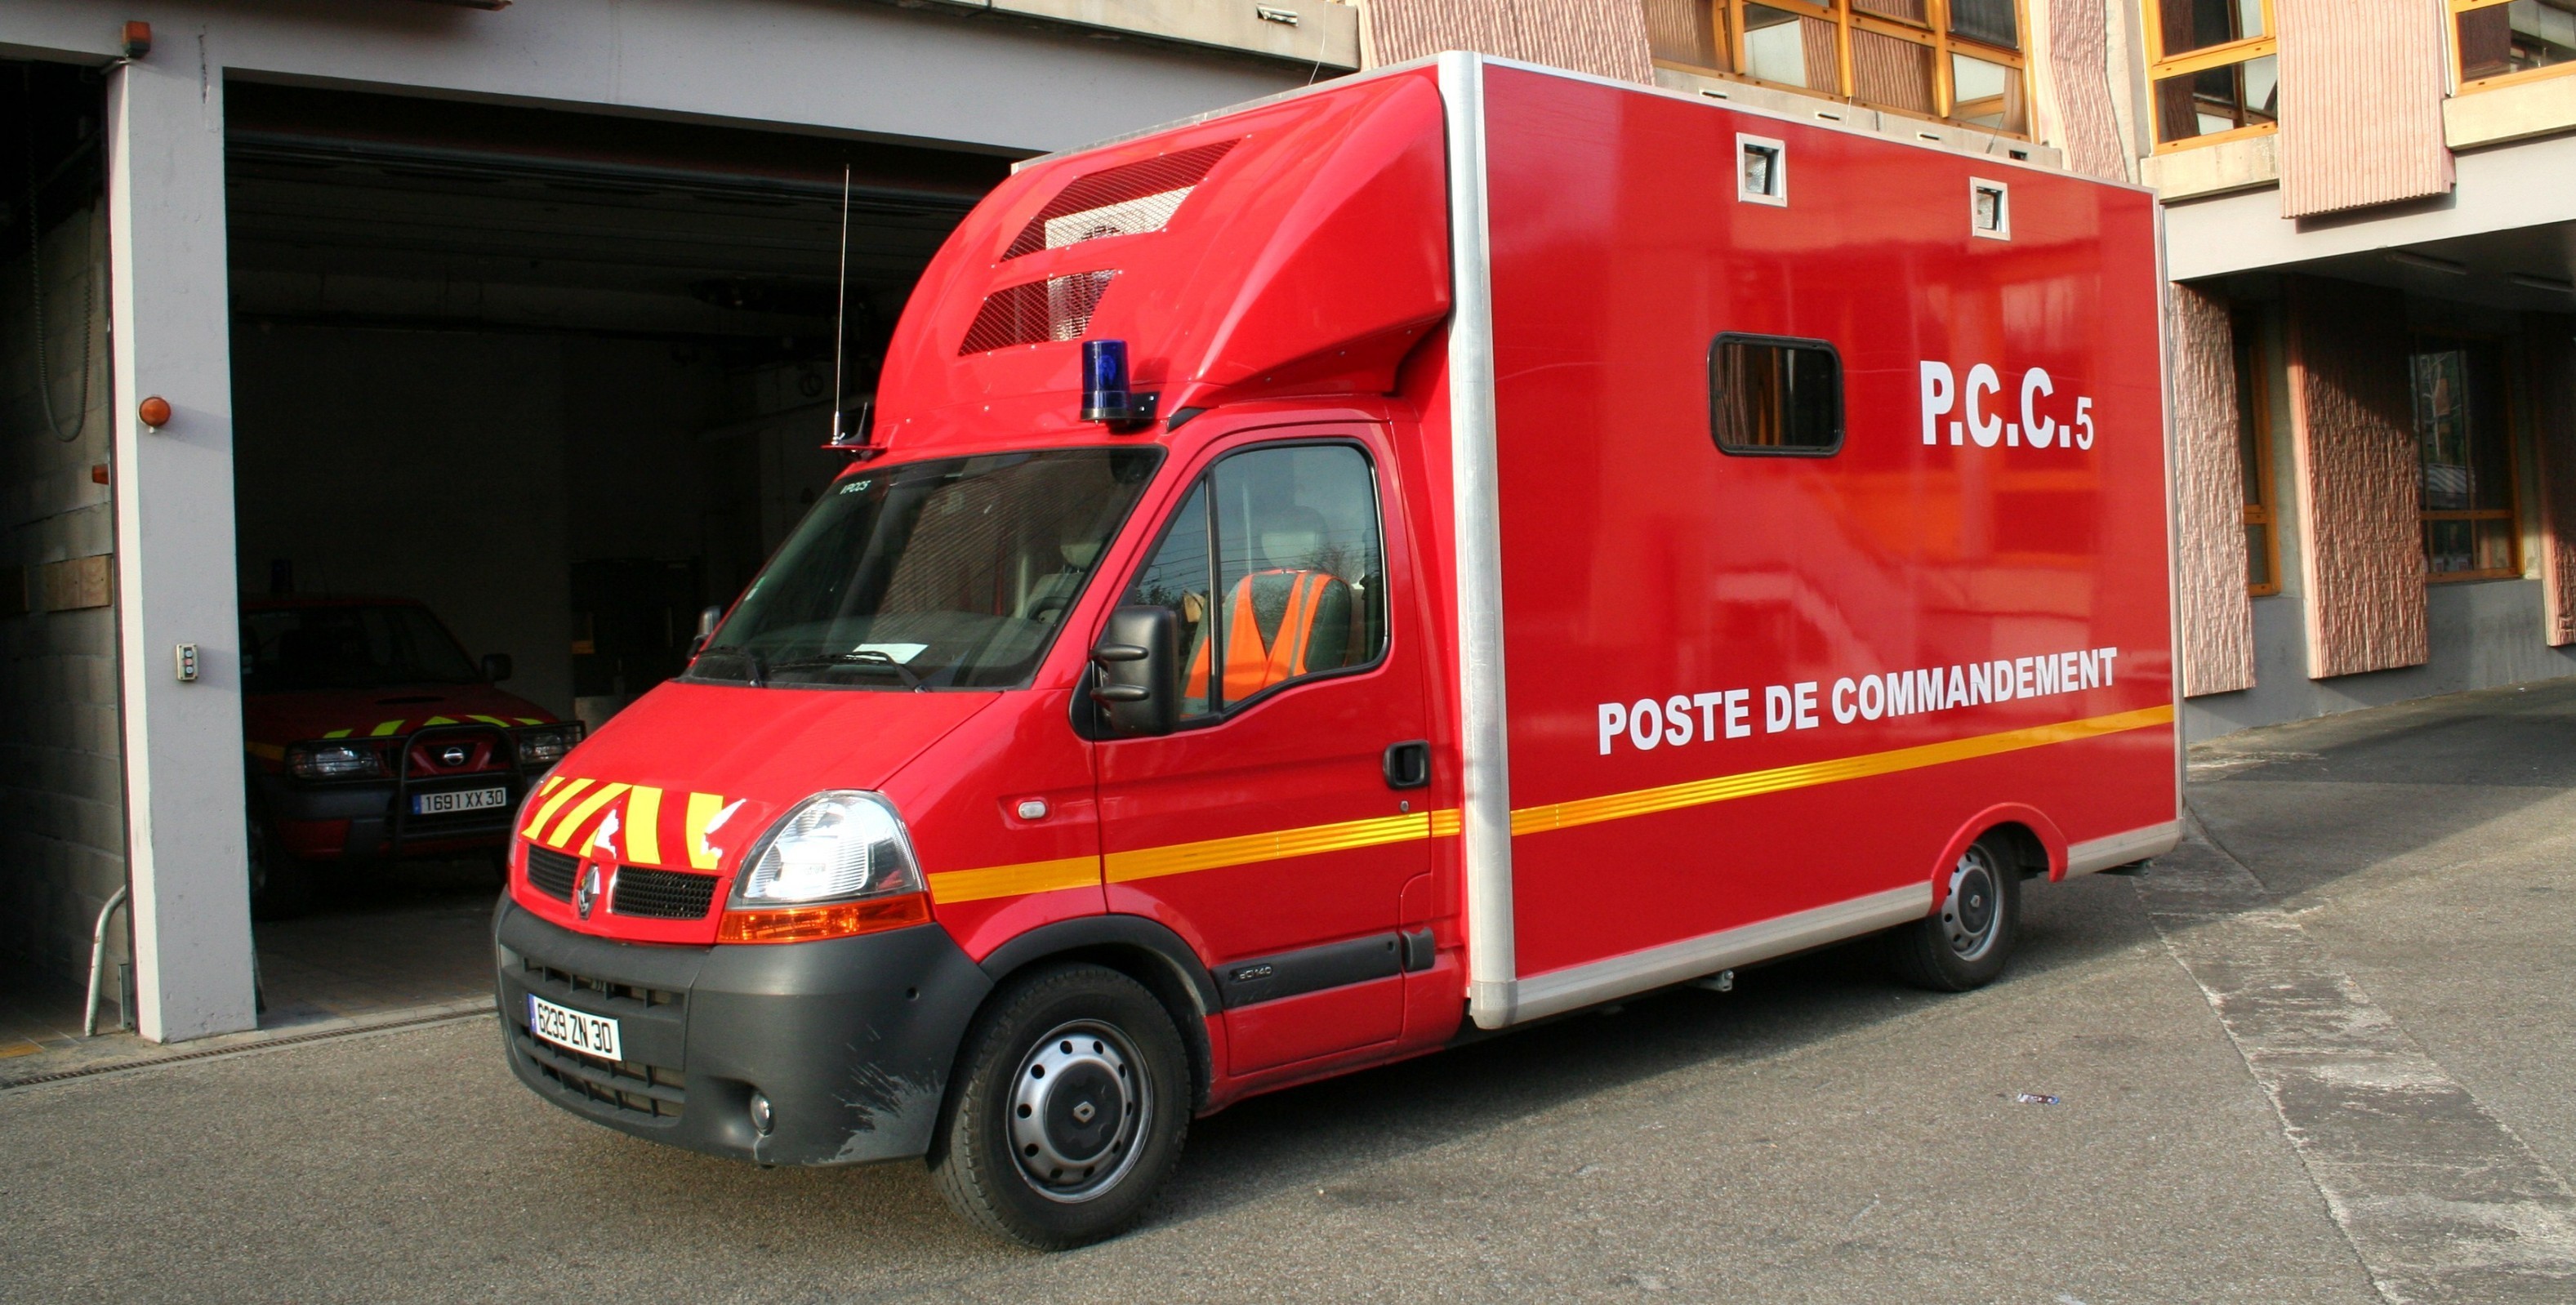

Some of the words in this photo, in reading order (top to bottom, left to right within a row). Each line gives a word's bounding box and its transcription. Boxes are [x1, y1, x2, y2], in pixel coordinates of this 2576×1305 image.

[1598, 688, 1751, 756] POSTE
[1765, 681, 1820, 734] DE
[1831, 647, 2118, 724] COMMANDEMENT
[426, 794, 461, 812] 1691
[465, 791, 484, 808] XX
[486, 789, 504, 806] 30
[537, 1003, 568, 1041] 6239
[569, 1013, 590, 1049] ZN
[591, 1020, 613, 1053] 30
